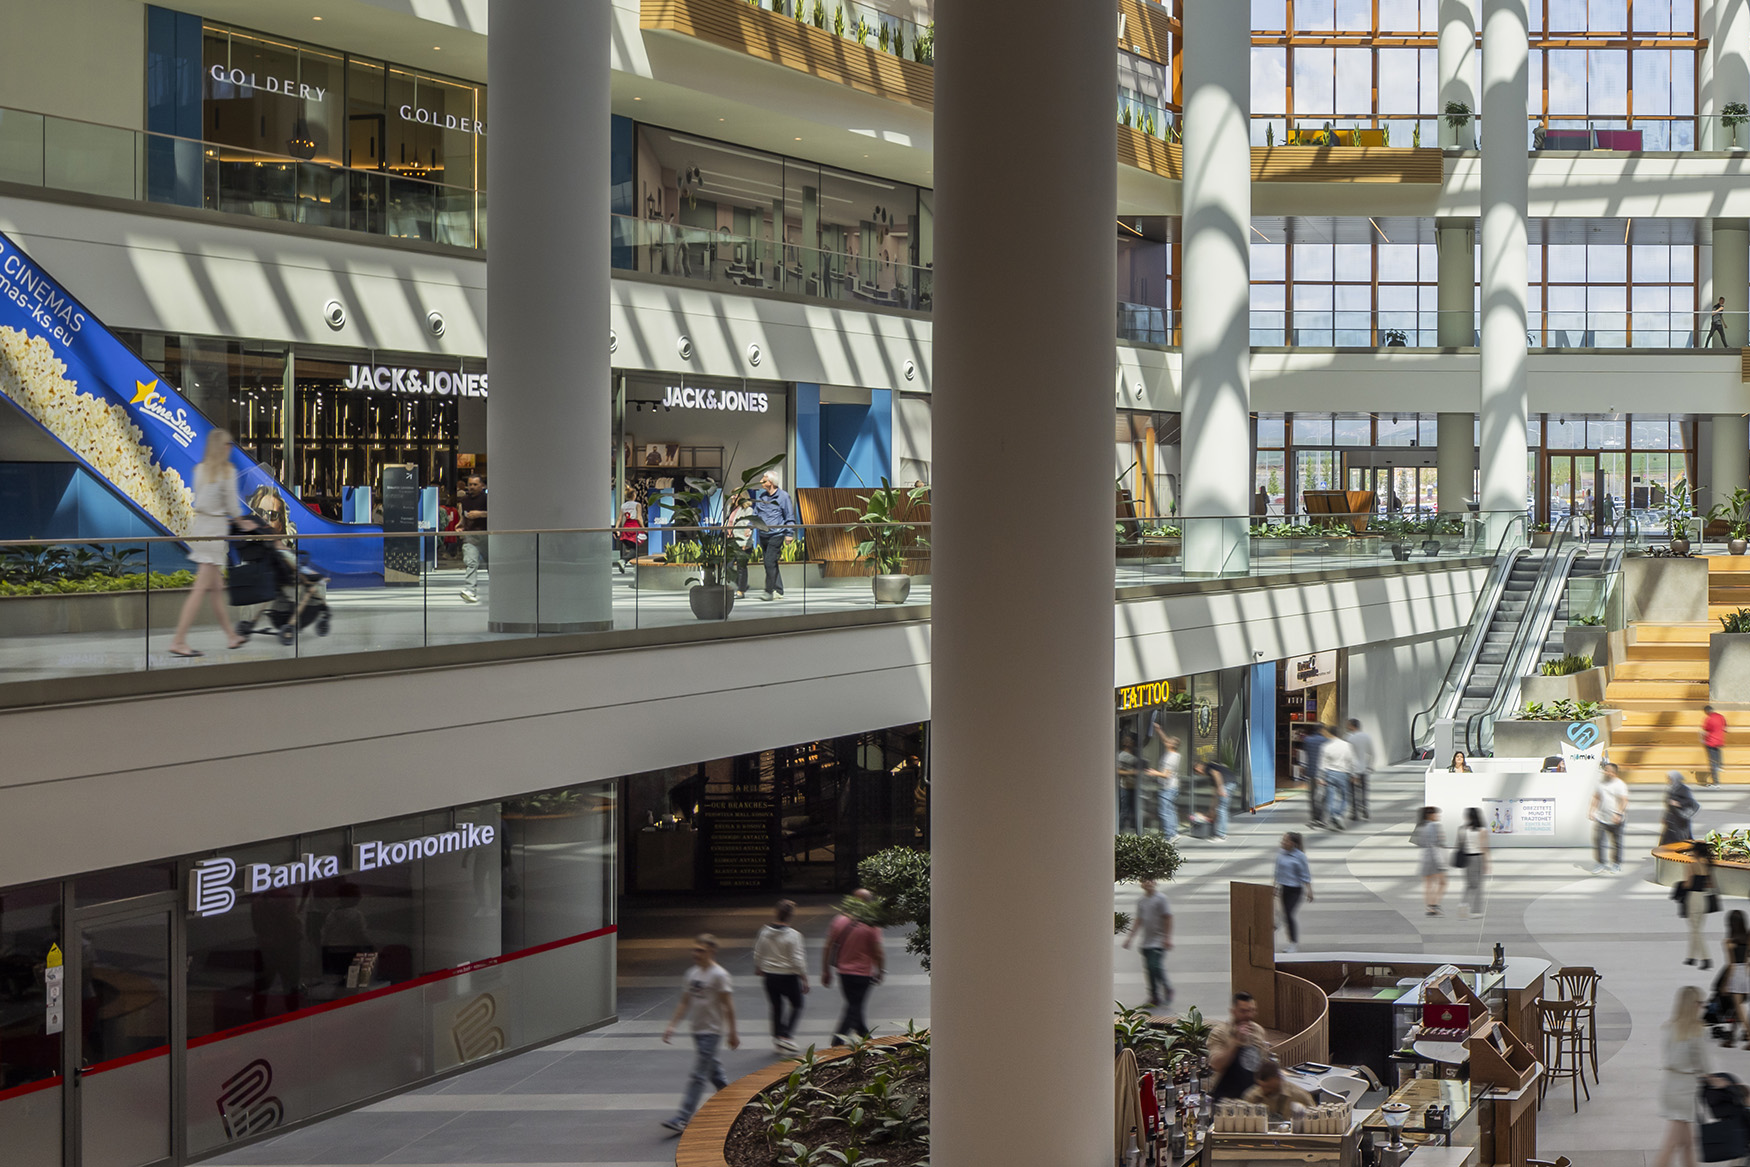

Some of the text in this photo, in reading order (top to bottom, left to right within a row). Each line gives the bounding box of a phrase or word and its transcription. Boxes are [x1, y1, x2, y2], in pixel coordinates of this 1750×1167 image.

[211, 64, 326, 102] GOLDERY
[400, 104, 488, 134] GOLDER
[4, 255, 86, 332] CINEMAS
[663, 386, 768, 413] JACK&JONES
[1120, 680, 1169, 710] TATTOO
[728, 801, 768, 809] BRANCHES
[251, 854, 339, 893] Banka
[359, 823, 495, 872] Ekonomike
